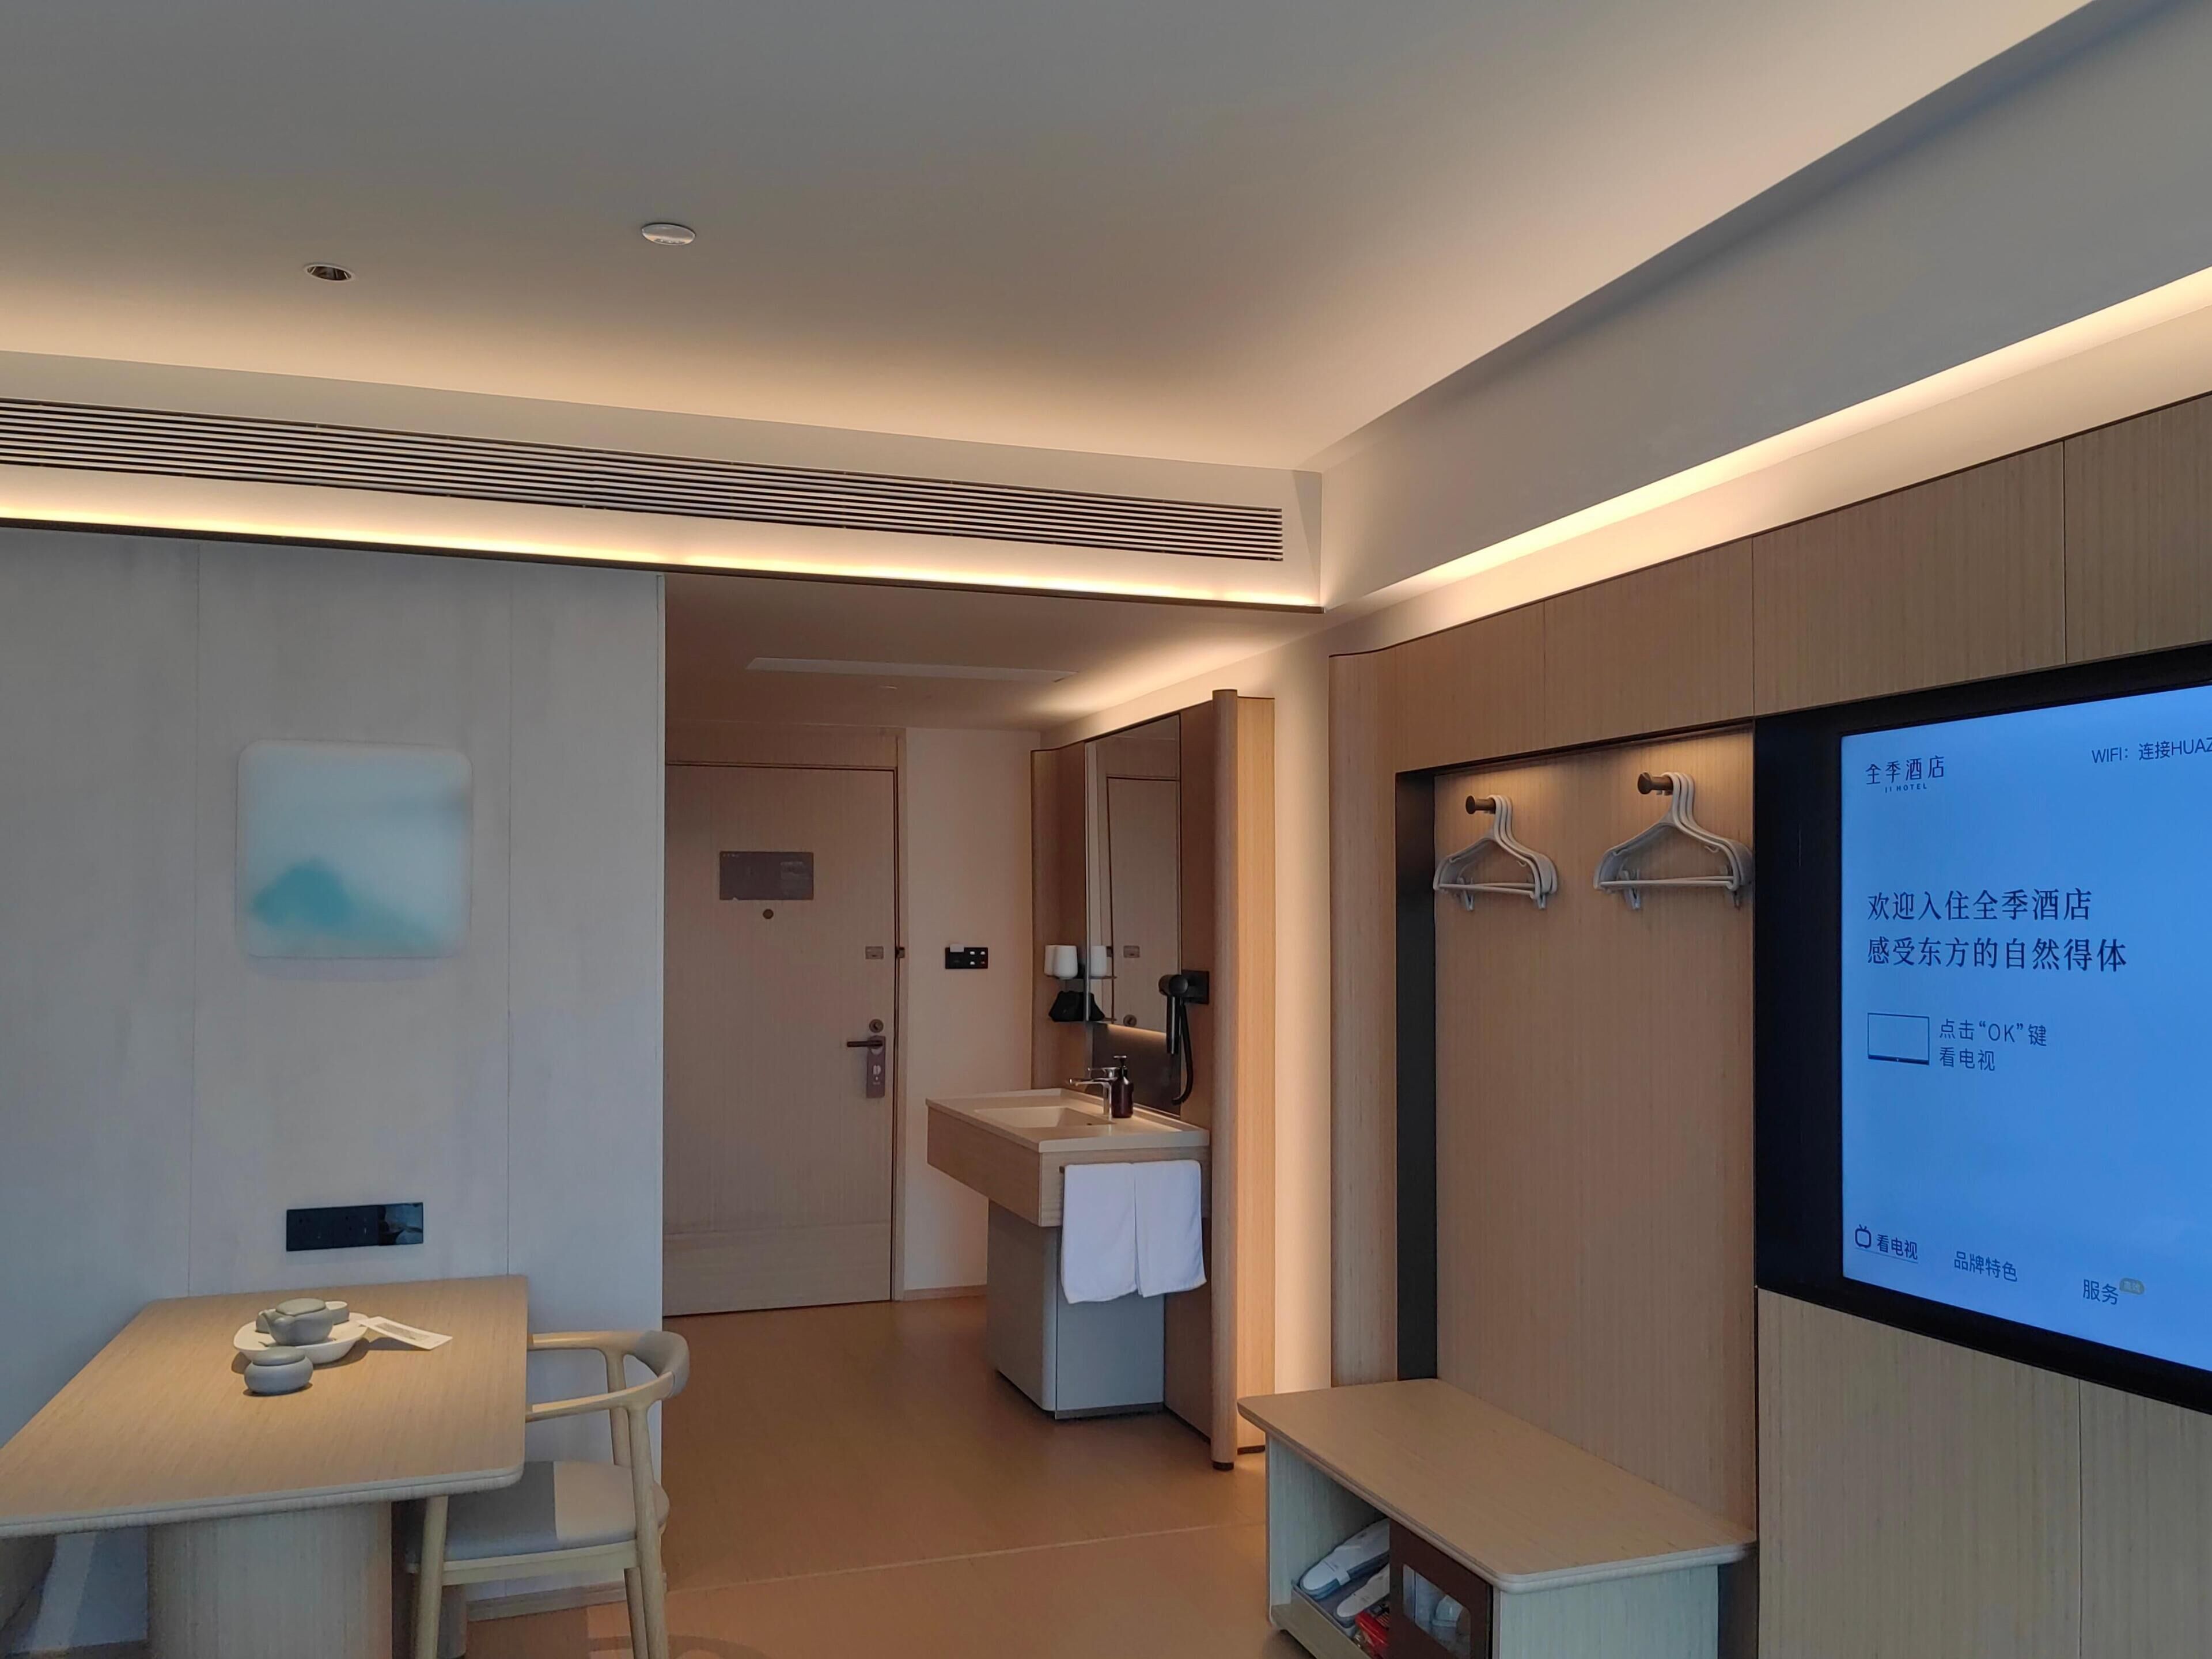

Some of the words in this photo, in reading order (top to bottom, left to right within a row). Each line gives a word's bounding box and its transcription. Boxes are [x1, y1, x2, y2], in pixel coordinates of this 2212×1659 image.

[1865, 755, 1944, 785] 全季酒店
[1896, 783, 1927, 791] HOTEL
[1868, 888, 2092, 921] 欢迎入住全季酒店
[1868, 936, 2127, 972] 感受东方的自然得体
[1940, 1047, 1995, 1071] 看电视
[1876, 1234, 1918, 1260] 看电视
[1954, 1251, 2018, 1282] 品牌特色
[2082, 1279, 2119, 1305] 服务
